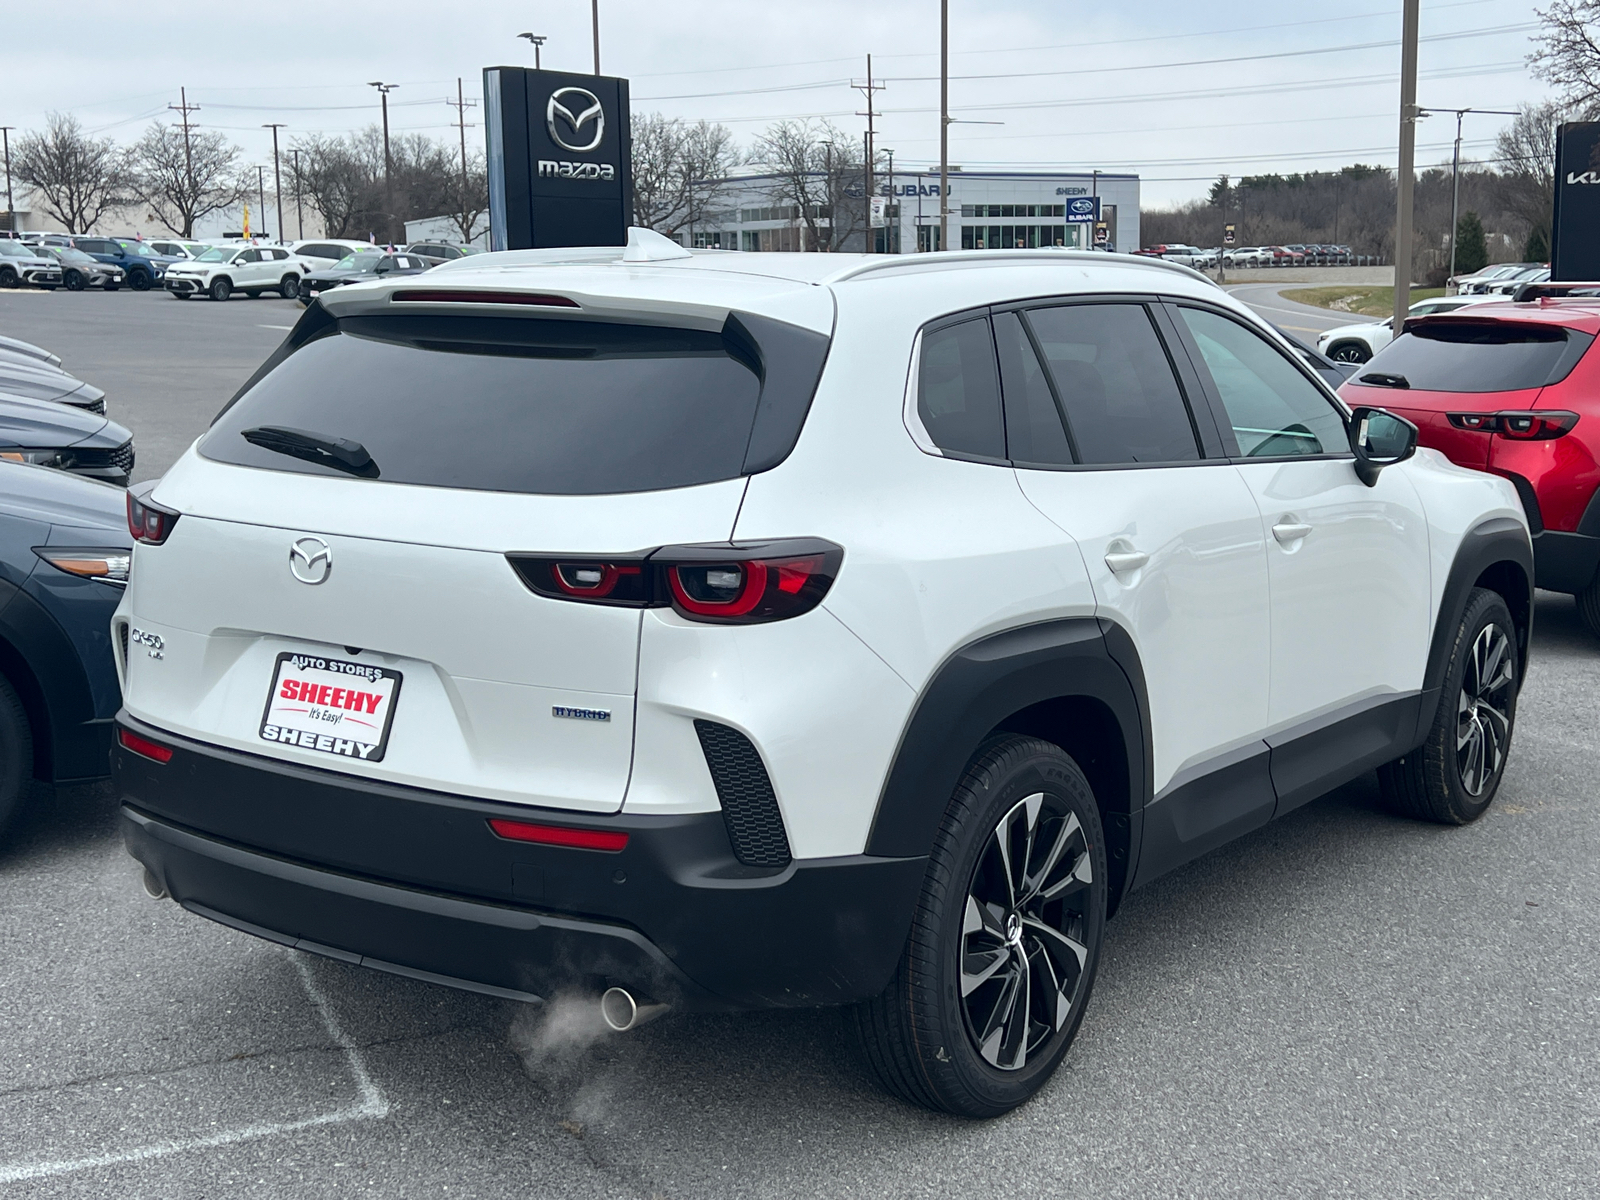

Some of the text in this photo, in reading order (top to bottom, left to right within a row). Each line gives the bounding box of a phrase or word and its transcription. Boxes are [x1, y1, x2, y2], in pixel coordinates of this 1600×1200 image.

[1567, 171, 1600, 184] KI
[1055, 187, 1088, 195] SHEEHY
[291, 655, 383, 679] AUTO STORES
[280, 679, 383, 714] SHEEHY
[309, 707, 344, 725] It's Easy!
[555, 706, 607, 720] HYBRID
[262, 724, 377, 759] SHEEHY
